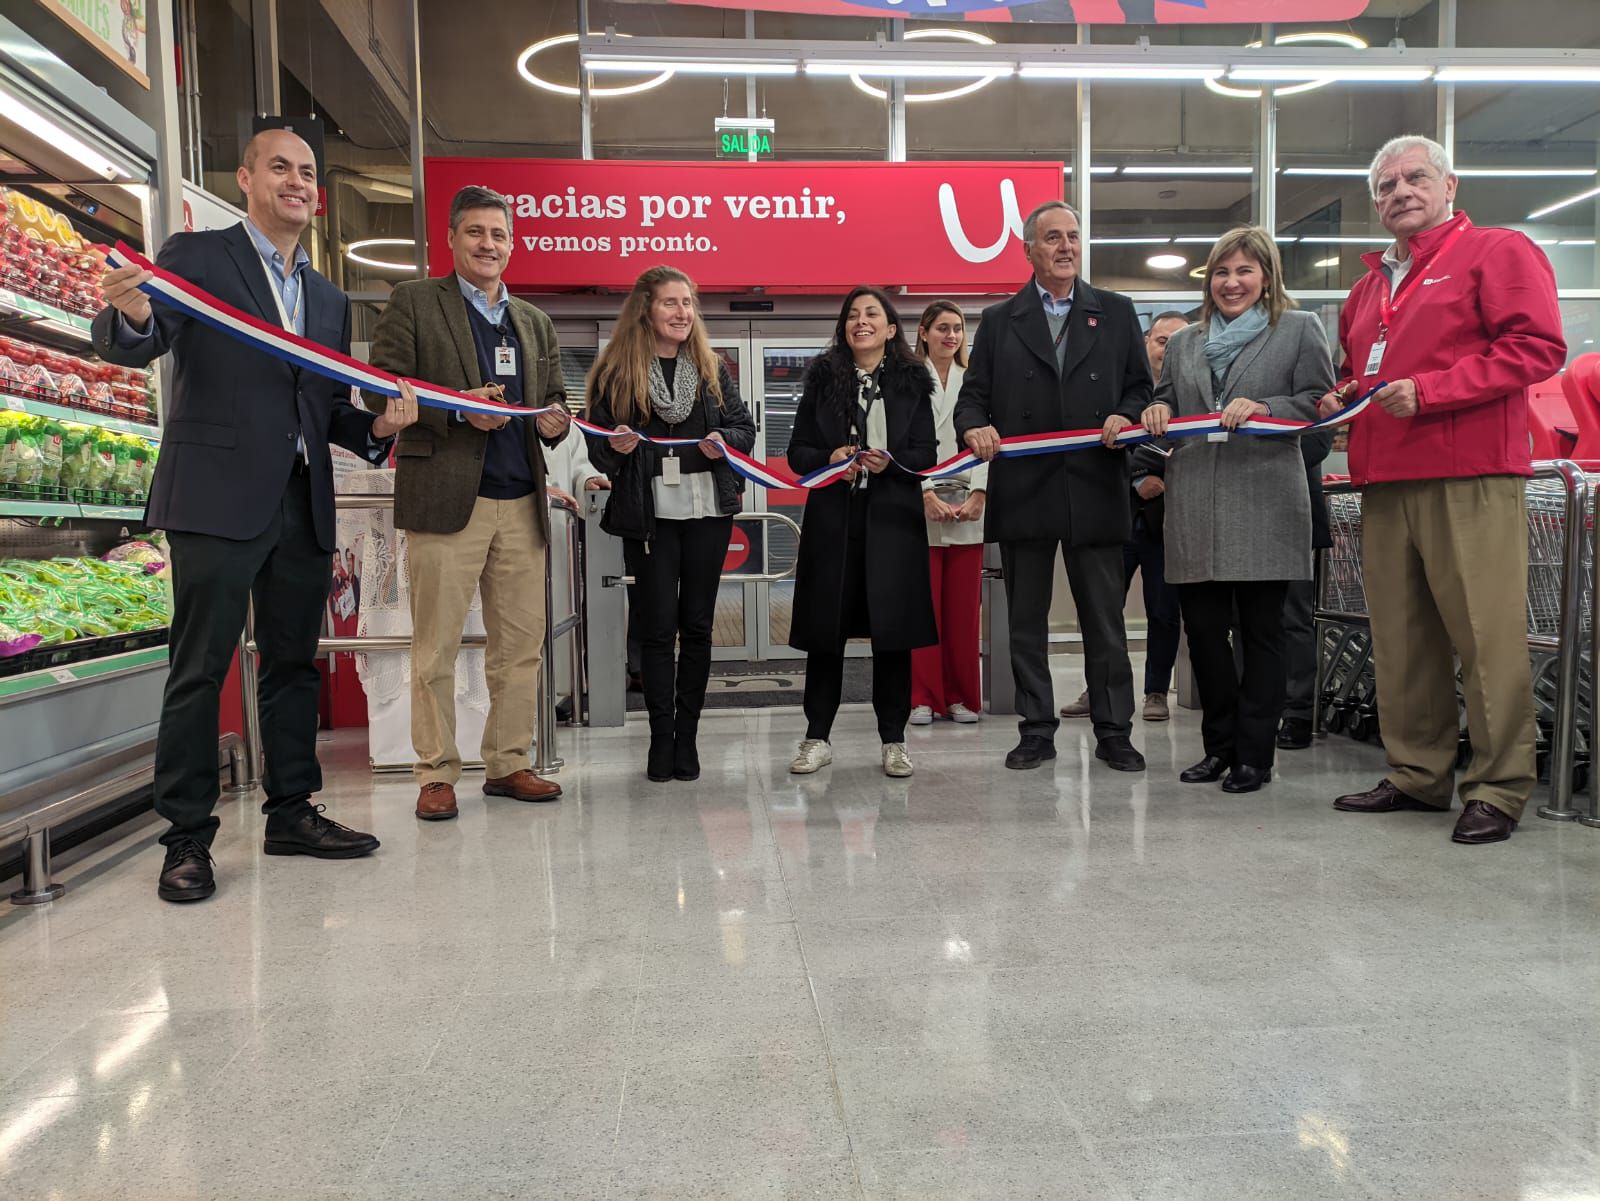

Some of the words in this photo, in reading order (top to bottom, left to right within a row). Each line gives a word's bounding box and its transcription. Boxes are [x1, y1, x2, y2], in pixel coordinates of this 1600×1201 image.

[721, 134, 771, 153] SALIDA
[464, 185, 627, 219] acias
[639, 195, 712, 227] por
[723, 187, 846, 224] venir,
[522, 235, 612, 252] vemos
[619, 232, 718, 257] pronto.
